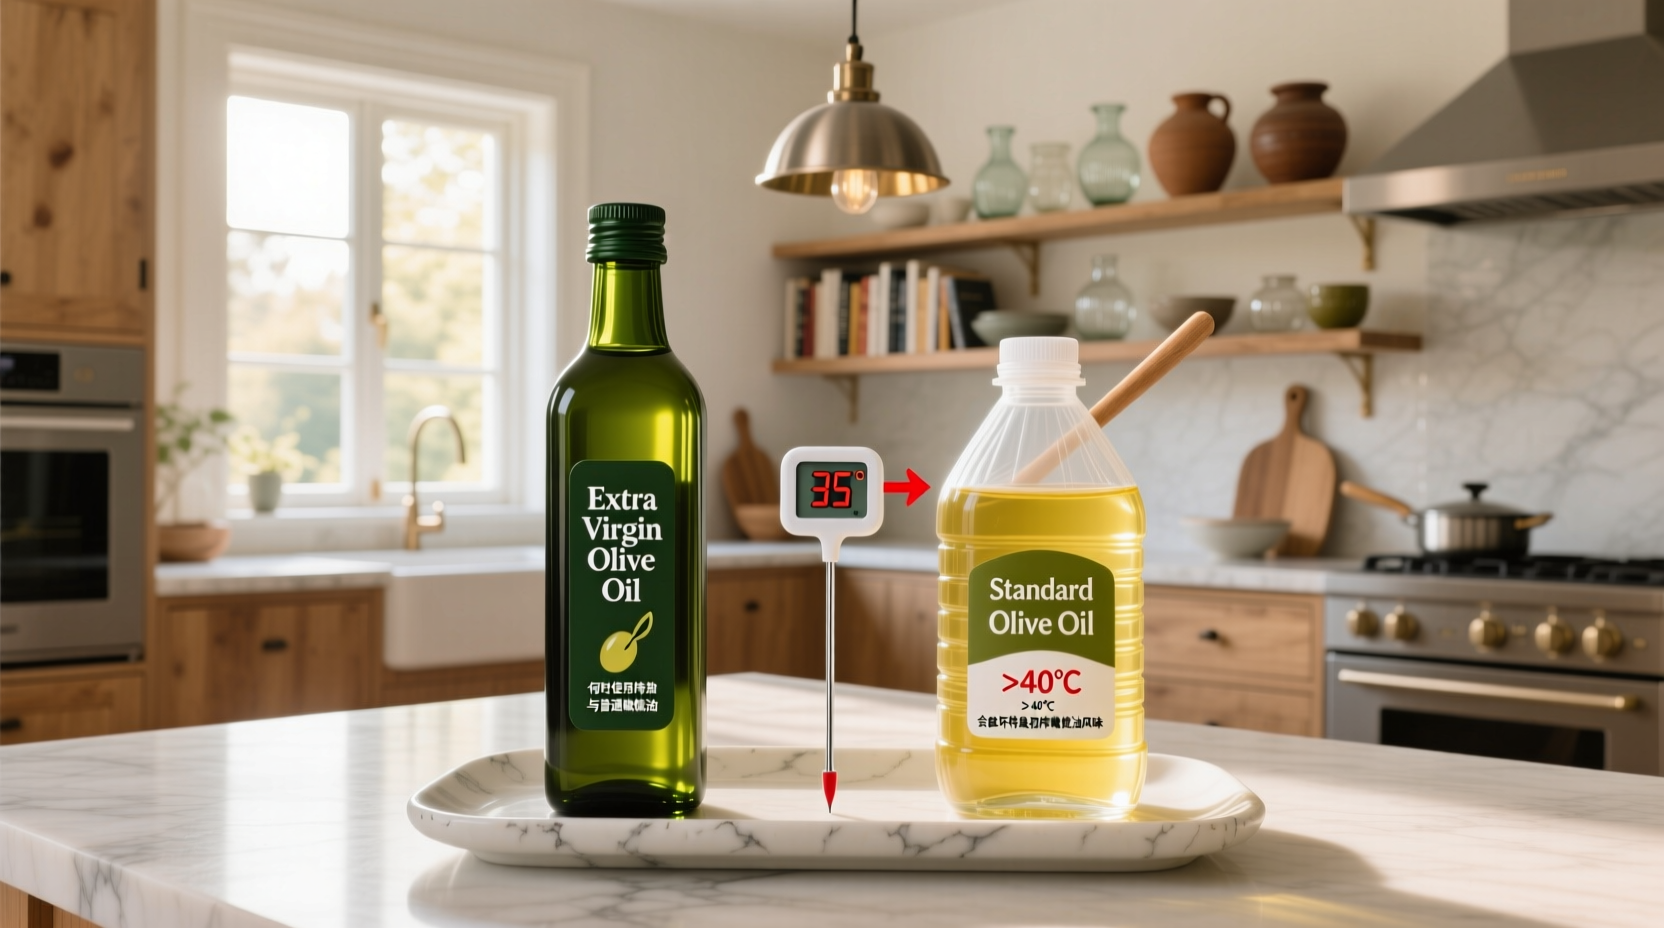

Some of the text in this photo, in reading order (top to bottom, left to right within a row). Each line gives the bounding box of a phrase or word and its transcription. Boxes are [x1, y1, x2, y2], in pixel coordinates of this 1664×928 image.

[587, 486, 658, 511] Extra
[582, 515, 663, 548] Virgin
[587, 546, 656, 572] Olive
[601, 577, 642, 603] Oil
[989, 576, 1094, 601] Standard
[988, 609, 1095, 636] Olive Oil
